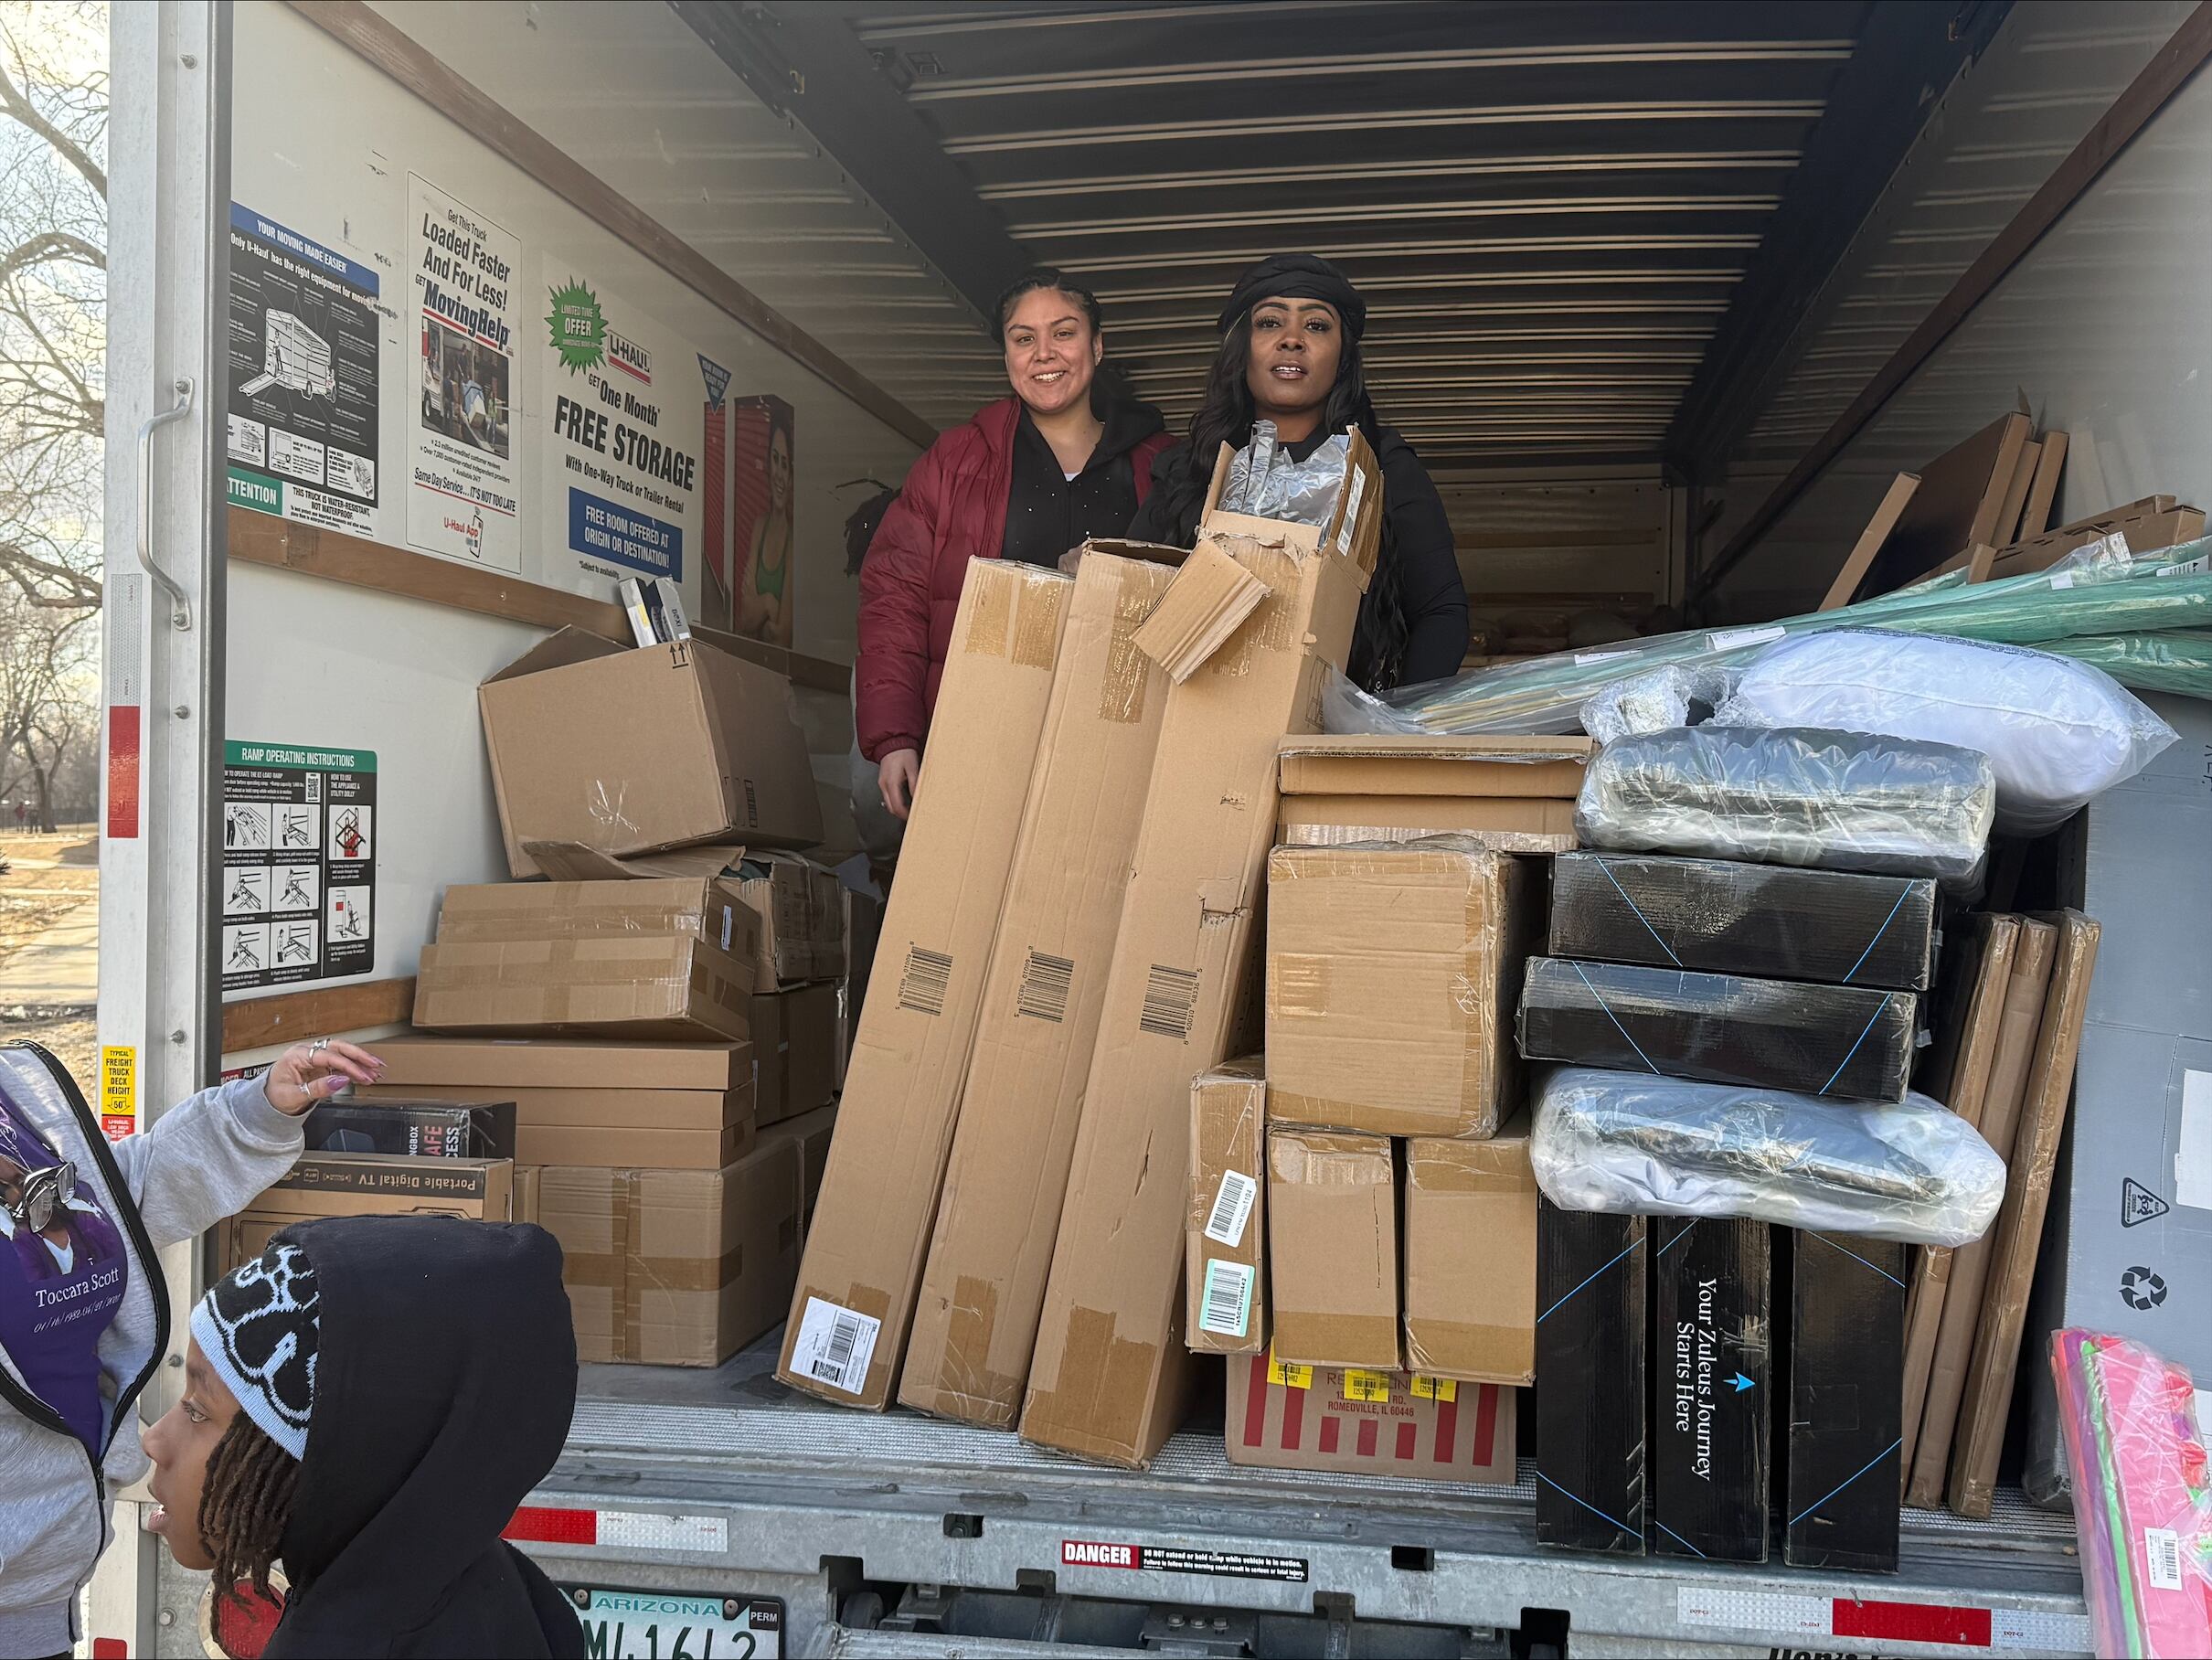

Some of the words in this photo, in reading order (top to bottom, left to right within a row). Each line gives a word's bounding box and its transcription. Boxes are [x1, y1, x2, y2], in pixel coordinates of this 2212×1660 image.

[448, 209, 458, 225] Get
[459, 215, 470, 232] This
[471, 223, 487, 242] Truck
[257, 219, 276, 240] YOUR
[277, 230, 303, 253] MOVING
[304, 243, 324, 263] MADE
[324, 254, 347, 274] EASIER
[422, 213, 470, 261] Loaded
[472, 241, 510, 283] Faster
[230, 232, 246, 251] Only
[247, 239, 269, 260] U-Haul
[271, 251, 282, 267] has
[284, 257, 294, 271] the
[295, 264, 310, 280] right
[311, 272, 342, 294] equipment
[343, 285, 351, 298] for
[423, 246, 451, 281] And
[452, 261, 473, 293] For
[475, 273, 508, 312] Less!
[415, 273, 425, 288] GET
[424, 279, 511, 352] MovingHelp
[561, 303, 581, 316] LIMITED
[581, 306, 594, 318] TIME
[564, 317, 592, 337] OFFER
[609, 334, 651, 374] U-HAUL
[588, 373, 601, 389] GET
[600, 379, 622, 410] One
[554, 395, 609, 454] FREE
[613, 423, 696, 493] STORAGE
[293, 486, 304, 497] THIS
[305, 489, 321, 502] TRUCK
[322, 494, 328, 503] IS
[415, 467, 431, 484] Same
[431, 472, 442, 490] Day
[470, 486, 482, 500] IT'S
[481, 489, 493, 505] NOT
[493, 494, 503, 508] TOO
[503, 498, 516, 513] LATE
[566, 453, 582, 474] With
[584, 462, 614, 489] One-Way
[616, 474, 634, 495] Truck
[634, 484, 643, 497] or
[643, 487, 664, 505] Trailer
[665, 496, 684, 515] Rental
[311, 501, 320, 511] NOT
[443, 516, 465, 534] U-Haul
[465, 524, 479, 538] App
[585, 505, 605, 527] FREE
[606, 511, 628, 533] ROOM
[629, 521, 659, 546] OFFERED
[660, 532, 669, 549] AT
[584, 526, 611, 549] ORIGIN
[611, 535, 622, 553] OR
[624, 539, 670, 569] DESTINATION!
[242, 747, 265, 761] RAMP
[266, 750, 305, 764] OPERATING
[306, 752, 355, 768] INSTRUCTIONS
[106, 1058, 133, 1067] FREIGHT
[109, 1068, 130, 1076] TRUCK
[107, 1087, 130, 1095] HEIGHT
[111, 1077, 127, 1086] DECK
[409, 1126, 419, 1156] NGBOX
[423, 1125, 443, 1156] AFE
[446, 1126, 460, 1159] CESS
[358, 1174, 376, 1186] TV
[379, 1175, 420, 1189] Digital
[425, 1176, 476, 1191] Portable
[36, 1281, 90, 1308] Toccara
[90, 1267, 120, 1292] Scott
[1698, 1278, 1717, 1326] Your
[1676, 1321, 1695, 1379] Starts
[1697, 1328, 1717, 1396] Zuleus
[1328, 1400, 1379, 1416] ROMEOVILLE,
[1381, 1407, 1388, 1415] IL
[1392, 1394, 1407, 1405] RD.
[1676, 1383, 1695, 1432] Here
[1691, 1399, 1716, 1483] Journey
[1065, 1542, 1132, 1565] DANGER
[1143, 1549, 1153, 1558] DO
[1154, 1549, 1164, 1558] NOT
[1165, 1551, 1186, 1559] extend
[1195, 1552, 1207, 1560] hold
[1243, 1557, 1264, 1566] vehicle
[1280, 1559, 1303, 1568] motion.
[1194, 1563, 1214, 1571] warning
[1289, 1570, 1305, 1578] injury.
[595, 1597, 720, 1617] ARIZONA
[750, 1612, 778, 1623] PERM
